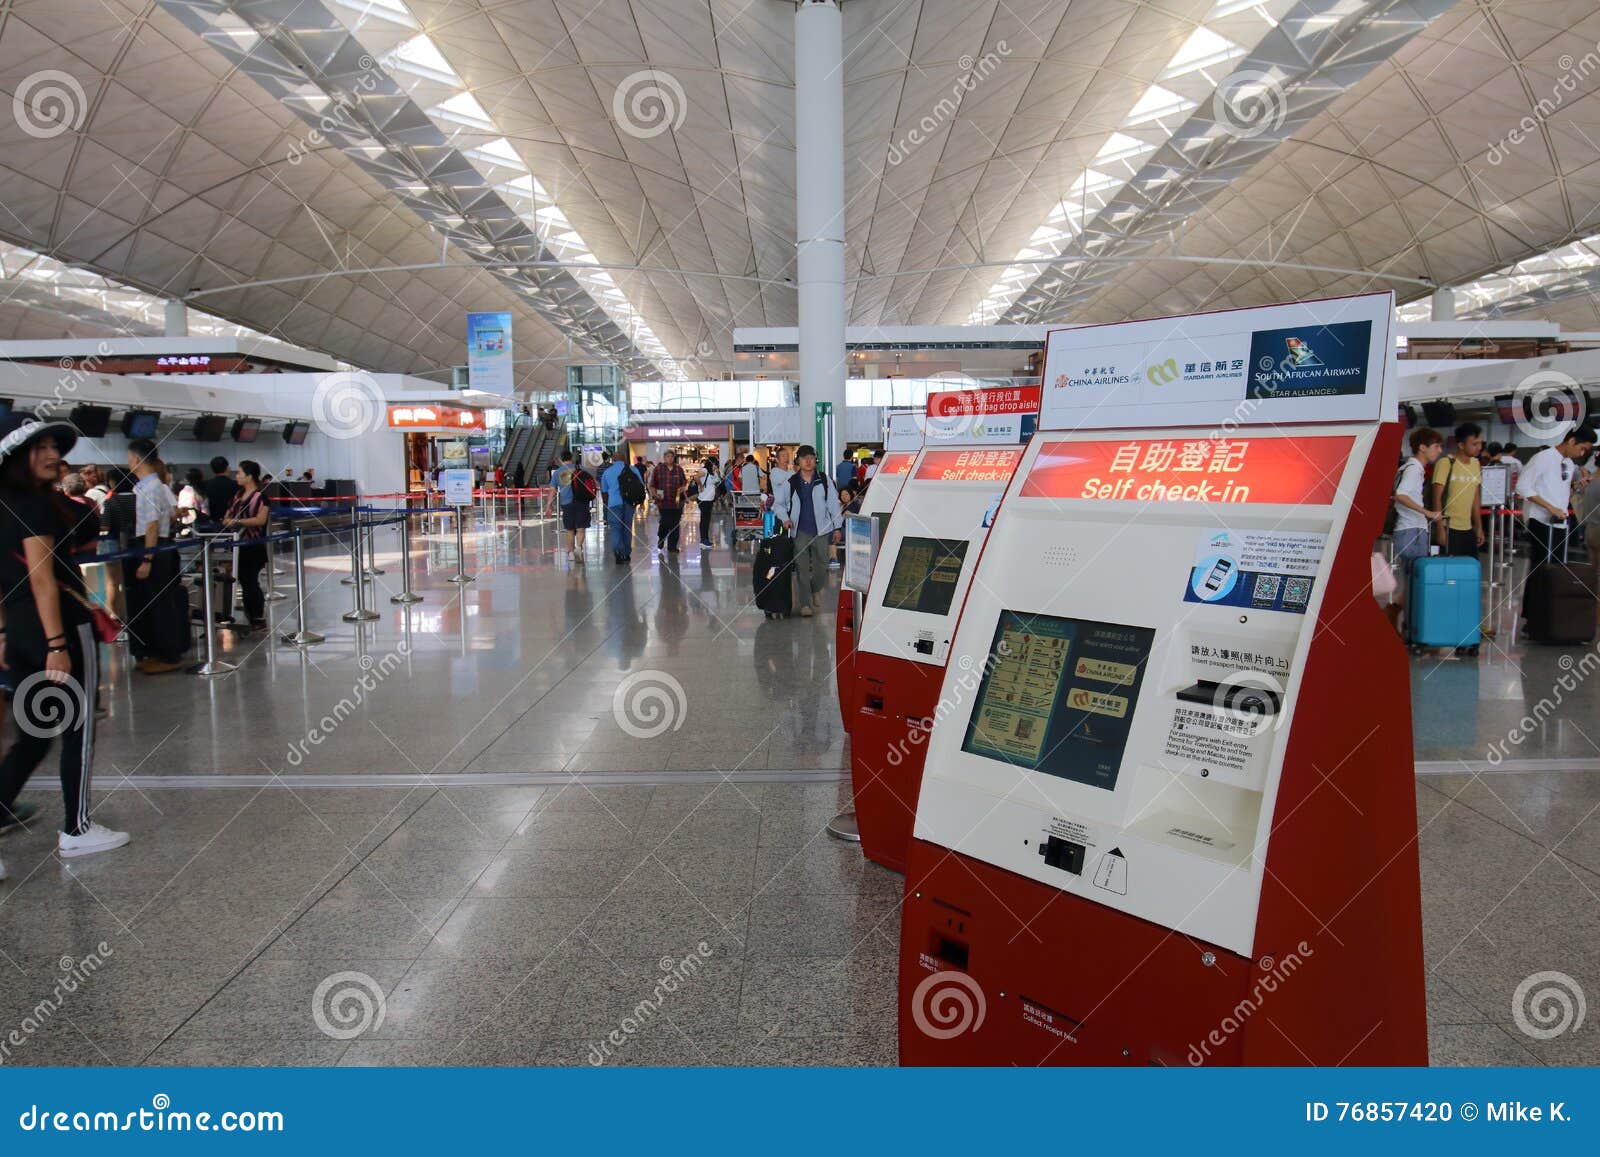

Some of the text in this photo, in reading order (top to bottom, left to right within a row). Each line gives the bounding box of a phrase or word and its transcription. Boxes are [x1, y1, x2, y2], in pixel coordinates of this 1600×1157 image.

[1285, 369, 1321, 380] AFRICAN
[1322, 367, 1361, 377] AIRWAYS
[1069, 375, 1129, 387] CHINA AIRLINES
[985, 402, 998, 412] bag
[1000, 400, 1017, 411] drop
[955, 451, 1014, 467] 自助登記
[1109, 441, 1249, 473] 自助登記
[941, 469, 1012, 481] Self check-in
[1081, 477, 1250, 503] Self check-in
